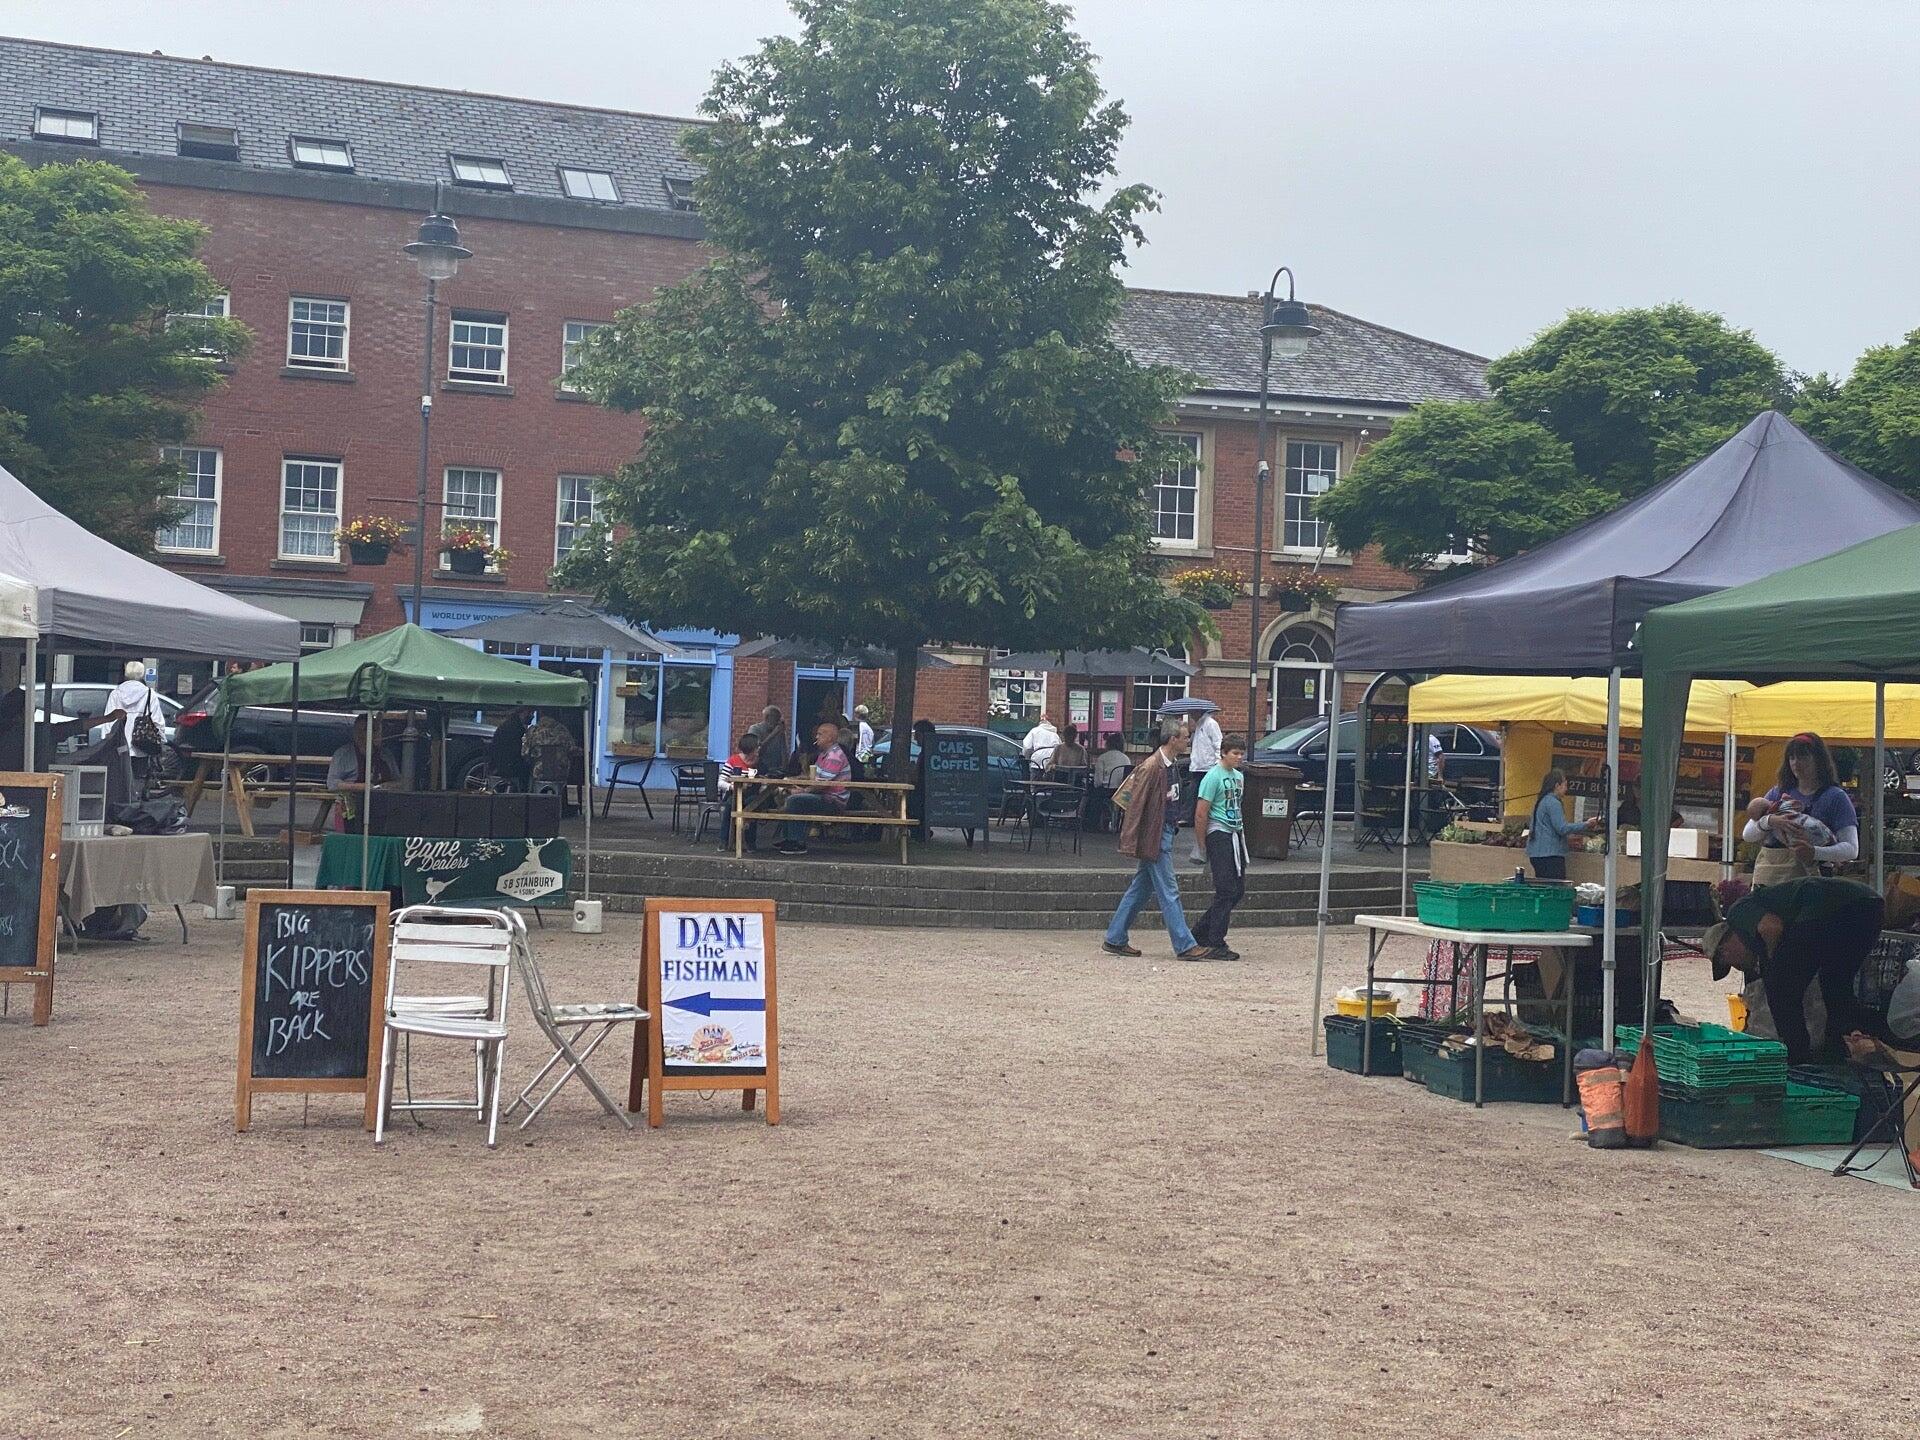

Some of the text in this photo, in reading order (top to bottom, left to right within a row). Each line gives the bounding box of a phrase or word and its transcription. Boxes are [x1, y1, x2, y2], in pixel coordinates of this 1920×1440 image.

[431, 611, 470, 621] WORLDLY
[930, 755, 980, 771] COFFEE
[404, 837, 461, 867] Game
[416, 855, 470, 873] Dealers
[502, 876, 555, 890] SB STANBURY
[276, 910, 311, 939] BIG
[677, 916, 746, 950] DAN
[697, 944, 724, 959] the
[265, 944, 369, 1003] KIPPERS
[663, 960, 759, 982] FISHMAN
[265, 1010, 332, 1057] BACK
